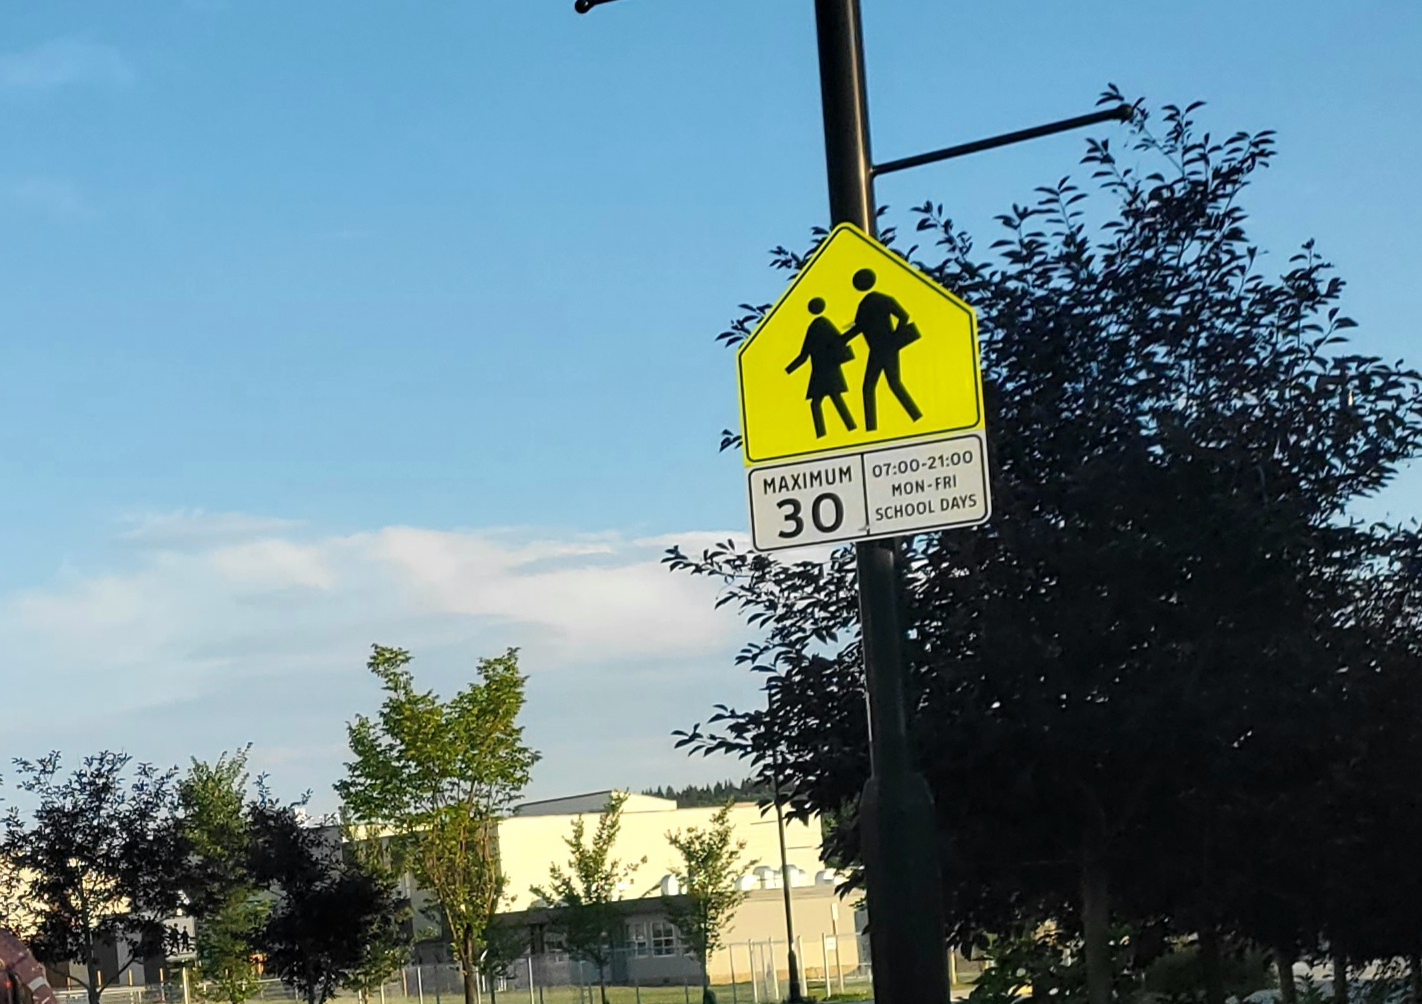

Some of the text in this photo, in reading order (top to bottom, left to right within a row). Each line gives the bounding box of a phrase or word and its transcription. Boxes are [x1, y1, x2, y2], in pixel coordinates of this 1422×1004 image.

[872, 450, 973, 478] 07:00-21:00
[763, 466, 852, 495] MAXIMUM
[776, 492, 844, 538] 30
[875, 494, 977, 521] SCHOOL DAYS
